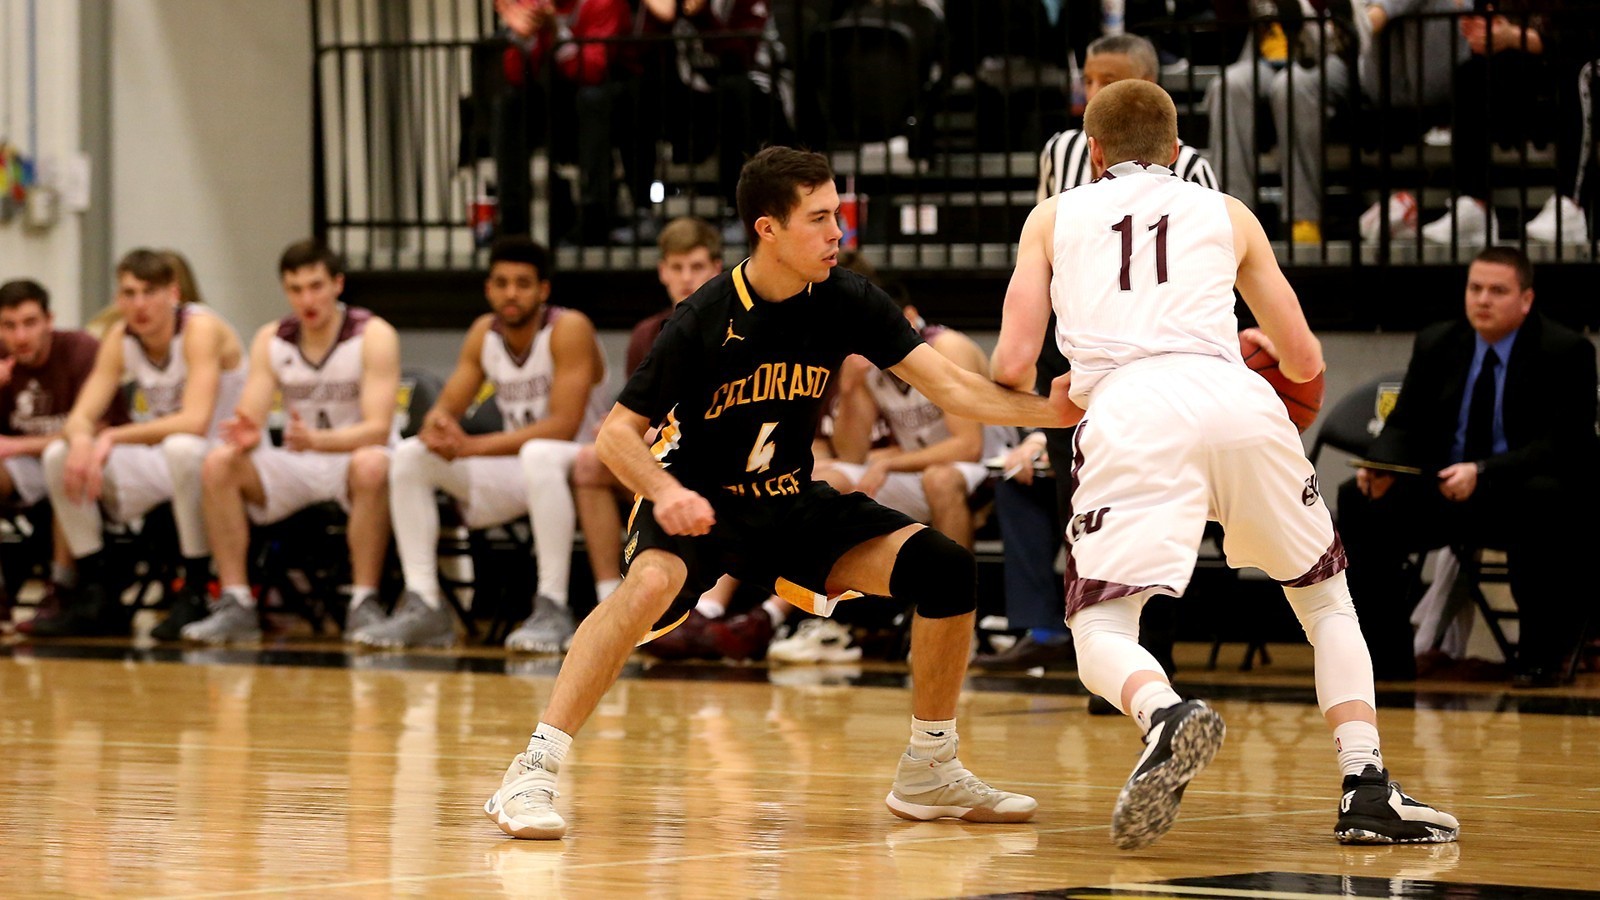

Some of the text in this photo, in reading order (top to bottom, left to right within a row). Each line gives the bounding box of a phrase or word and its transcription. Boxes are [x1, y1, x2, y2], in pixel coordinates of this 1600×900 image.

[1111, 213, 1170, 291] 11
[704, 362, 830, 420] COLORADO
[745, 421, 779, 474] 4
